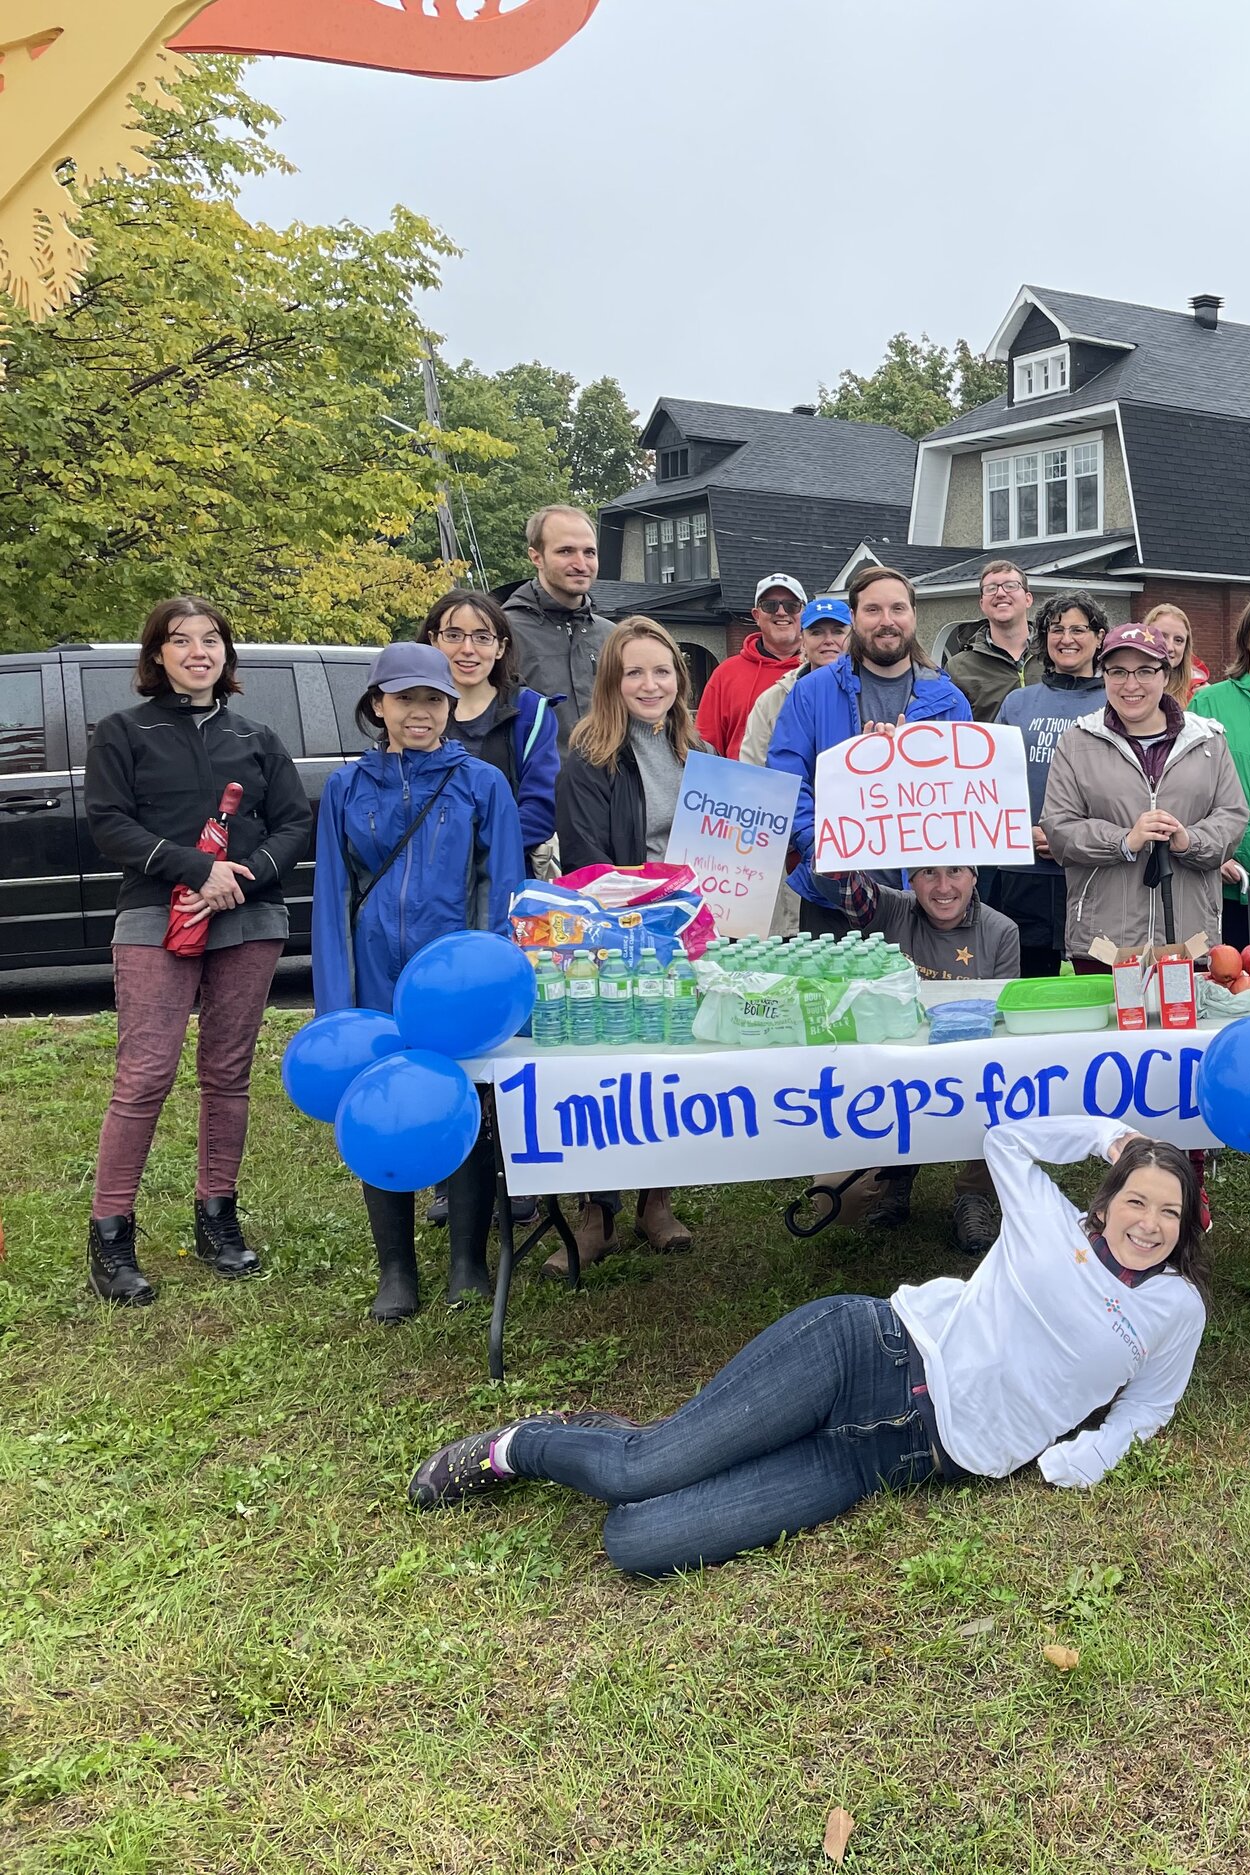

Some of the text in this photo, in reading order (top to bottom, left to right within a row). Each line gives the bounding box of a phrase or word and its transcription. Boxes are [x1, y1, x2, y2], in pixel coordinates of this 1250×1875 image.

[1028, 717, 1045, 731] MY
[1037, 731, 1054, 747] DO
[845, 723, 996, 775] OCD
[860, 778, 999, 810] IS NOT AN
[683, 790, 789, 835] Changing
[700, 815, 770, 855] Minds
[816, 808, 1030, 859] ADJECTIVE
[694, 856, 729, 874] million
[735, 866, 765, 881] steps
[702, 876, 749, 897] OCD
[499, 1063, 564, 1164] 1
[553, 1071, 760, 1151] million
[773, 1066, 965, 1155] steps
[975, 1061, 1070, 1130] for
